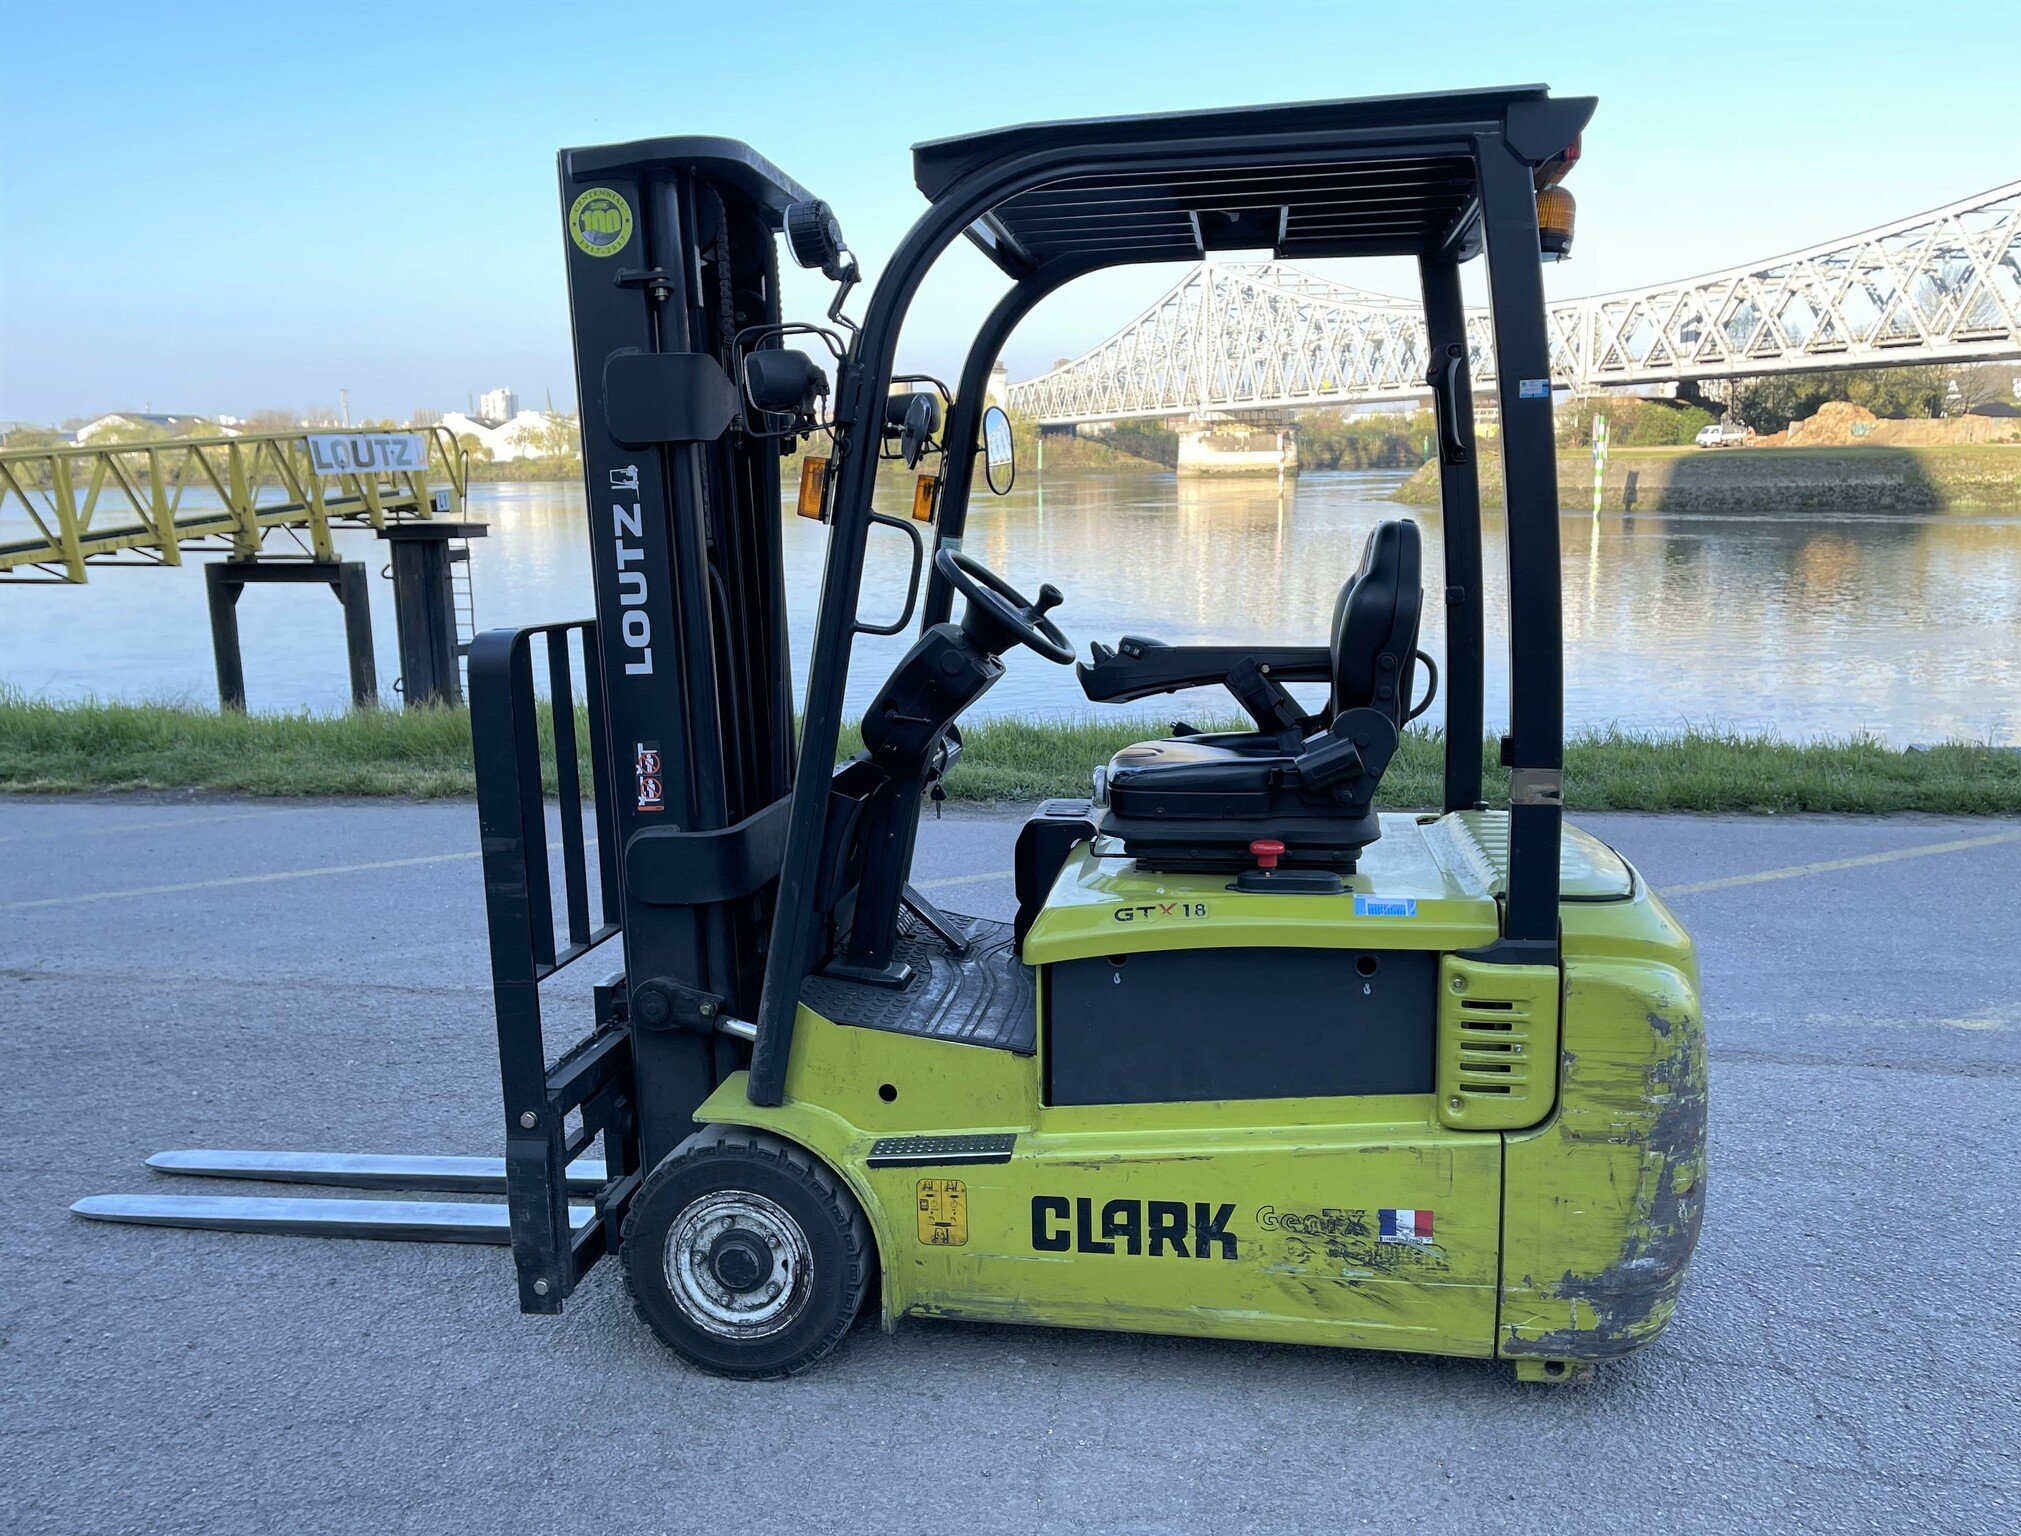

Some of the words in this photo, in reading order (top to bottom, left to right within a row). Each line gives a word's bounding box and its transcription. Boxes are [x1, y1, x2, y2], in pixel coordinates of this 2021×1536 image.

[574, 190, 624, 213] CENTENNIAL
[311, 438, 412, 469] LOUTZ
[613, 503, 653, 675] LOUTZ
[1032, 1195, 1239, 1260] CLARK
